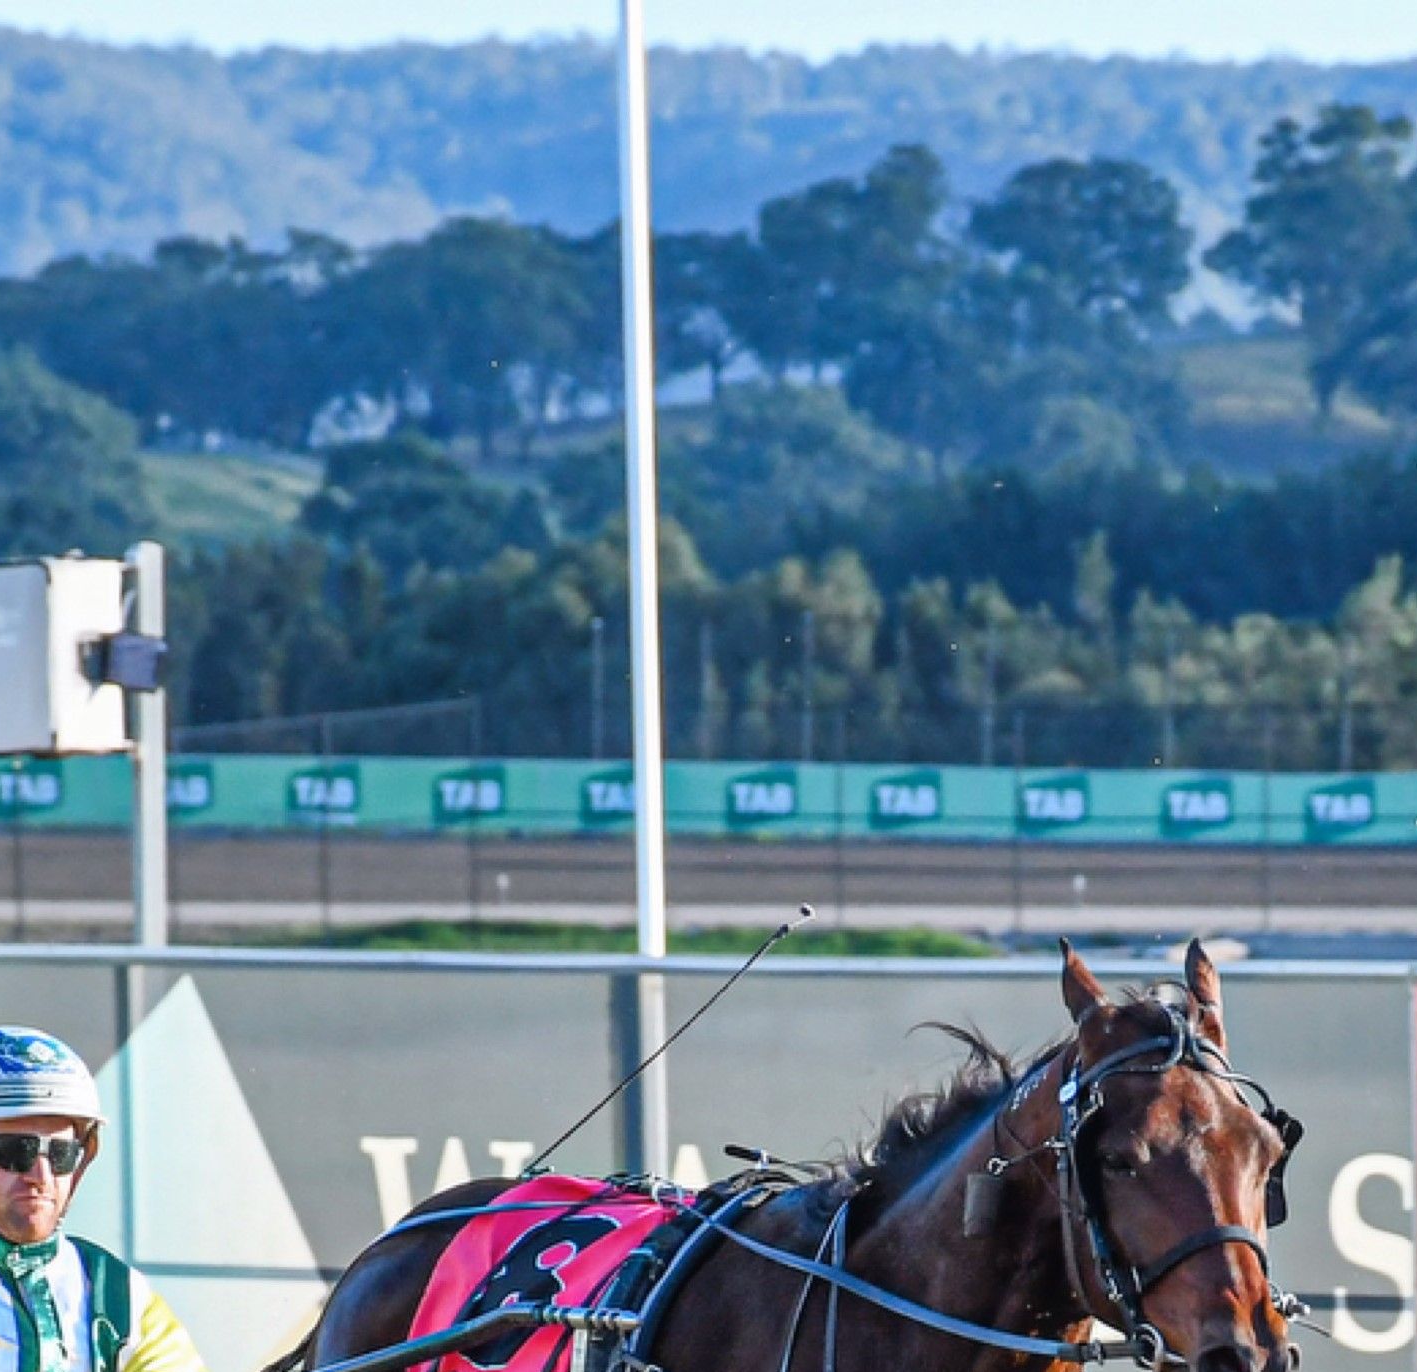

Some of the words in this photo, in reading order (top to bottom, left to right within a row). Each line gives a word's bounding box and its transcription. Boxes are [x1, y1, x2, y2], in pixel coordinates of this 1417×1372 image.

[294, 777, 354, 807] TAB
[441, 780, 499, 809] TAB
[589, 782, 634, 811] TA
[733, 783, 793, 813] TAB
[877, 785, 937, 816] TAB
[1024, 789, 1084, 819] TAB
[1169, 791, 1229, 820] TAB
[1311, 793, 1371, 822] TAB
